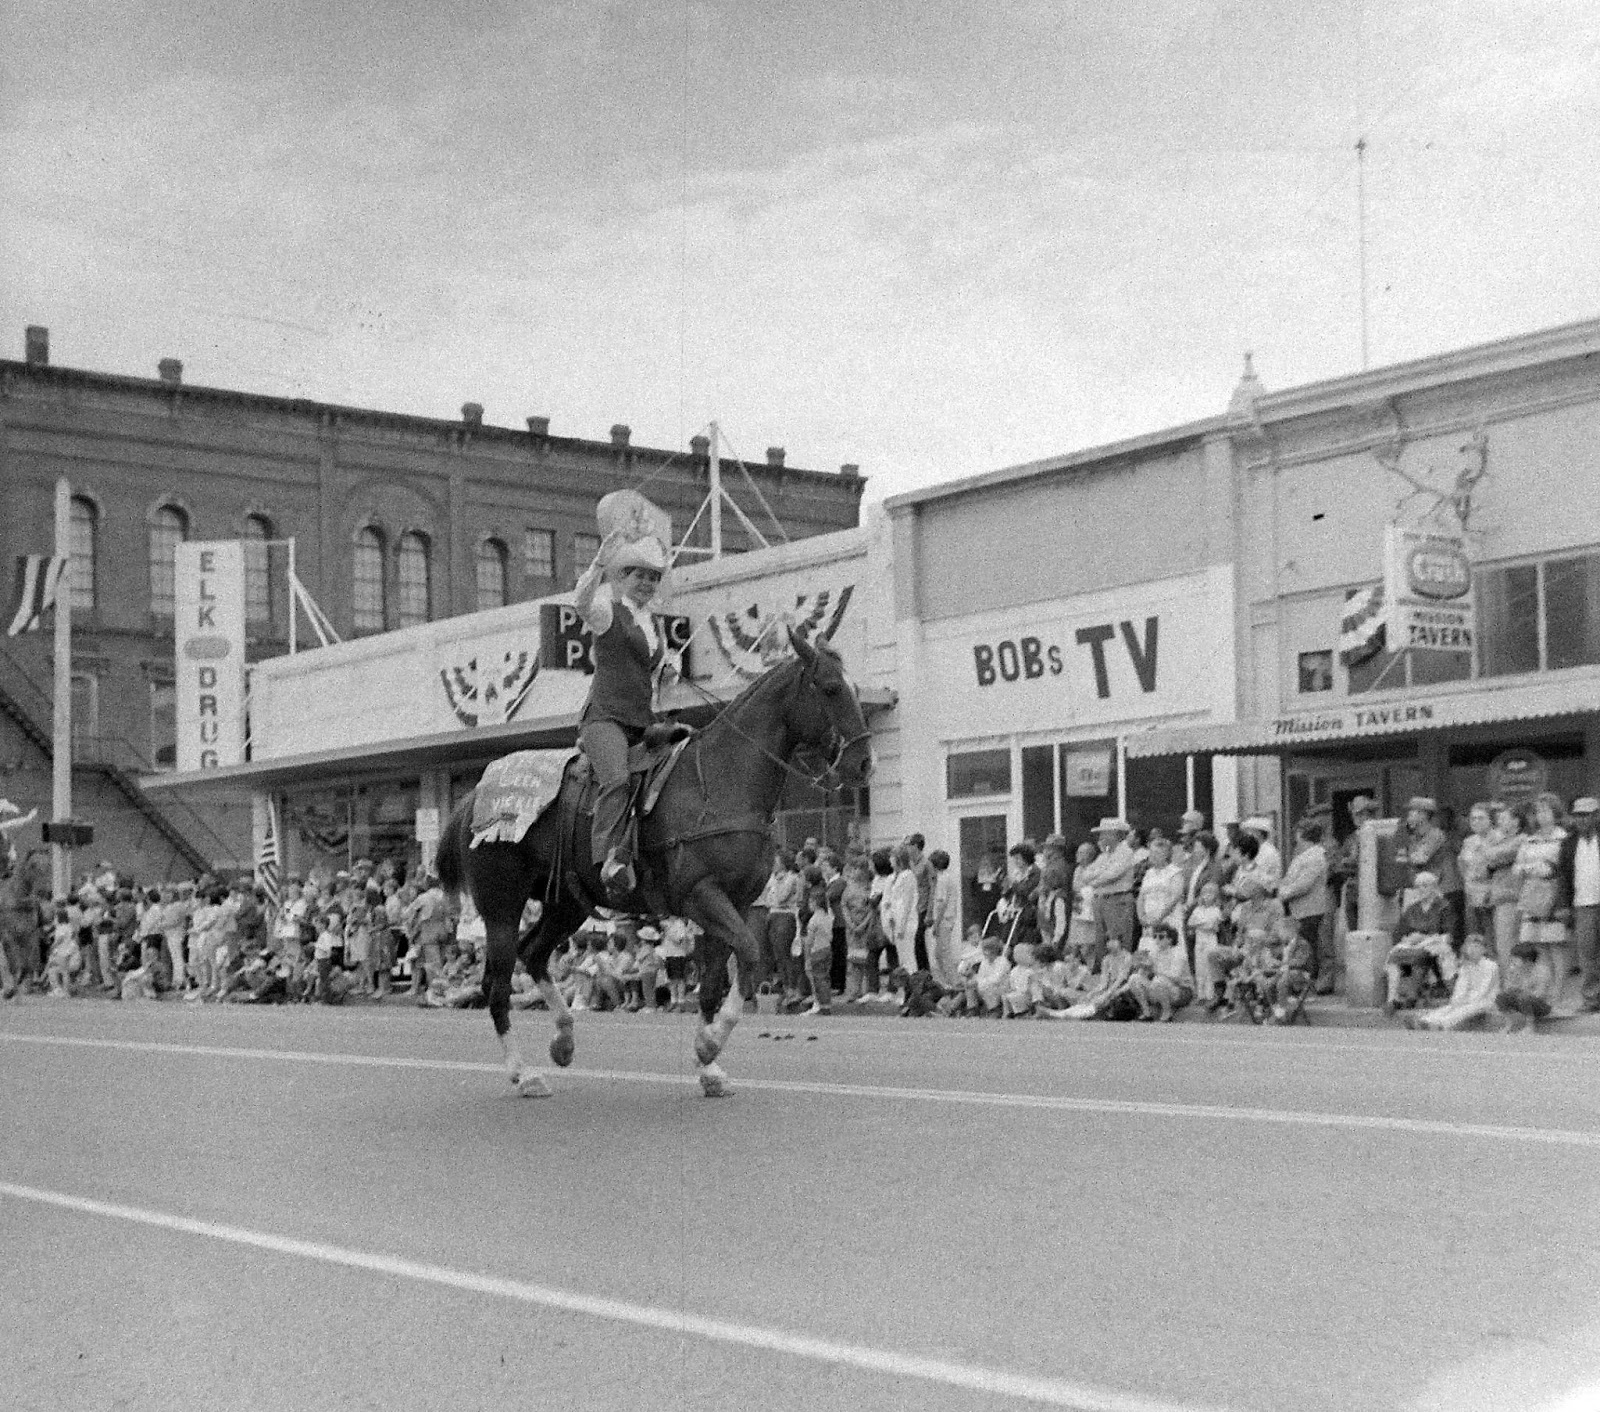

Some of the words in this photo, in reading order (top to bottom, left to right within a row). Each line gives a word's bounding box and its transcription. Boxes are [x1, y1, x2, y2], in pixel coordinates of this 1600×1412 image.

[200, 552, 216, 627] ELK
[1075, 616, 1159, 699] TV
[1407, 625, 1472, 647] TAVERN
[200, 667, 218, 769] DRUG
[1272, 715, 1344, 735] Mission
[1355, 705, 1433, 728] TAVERN
